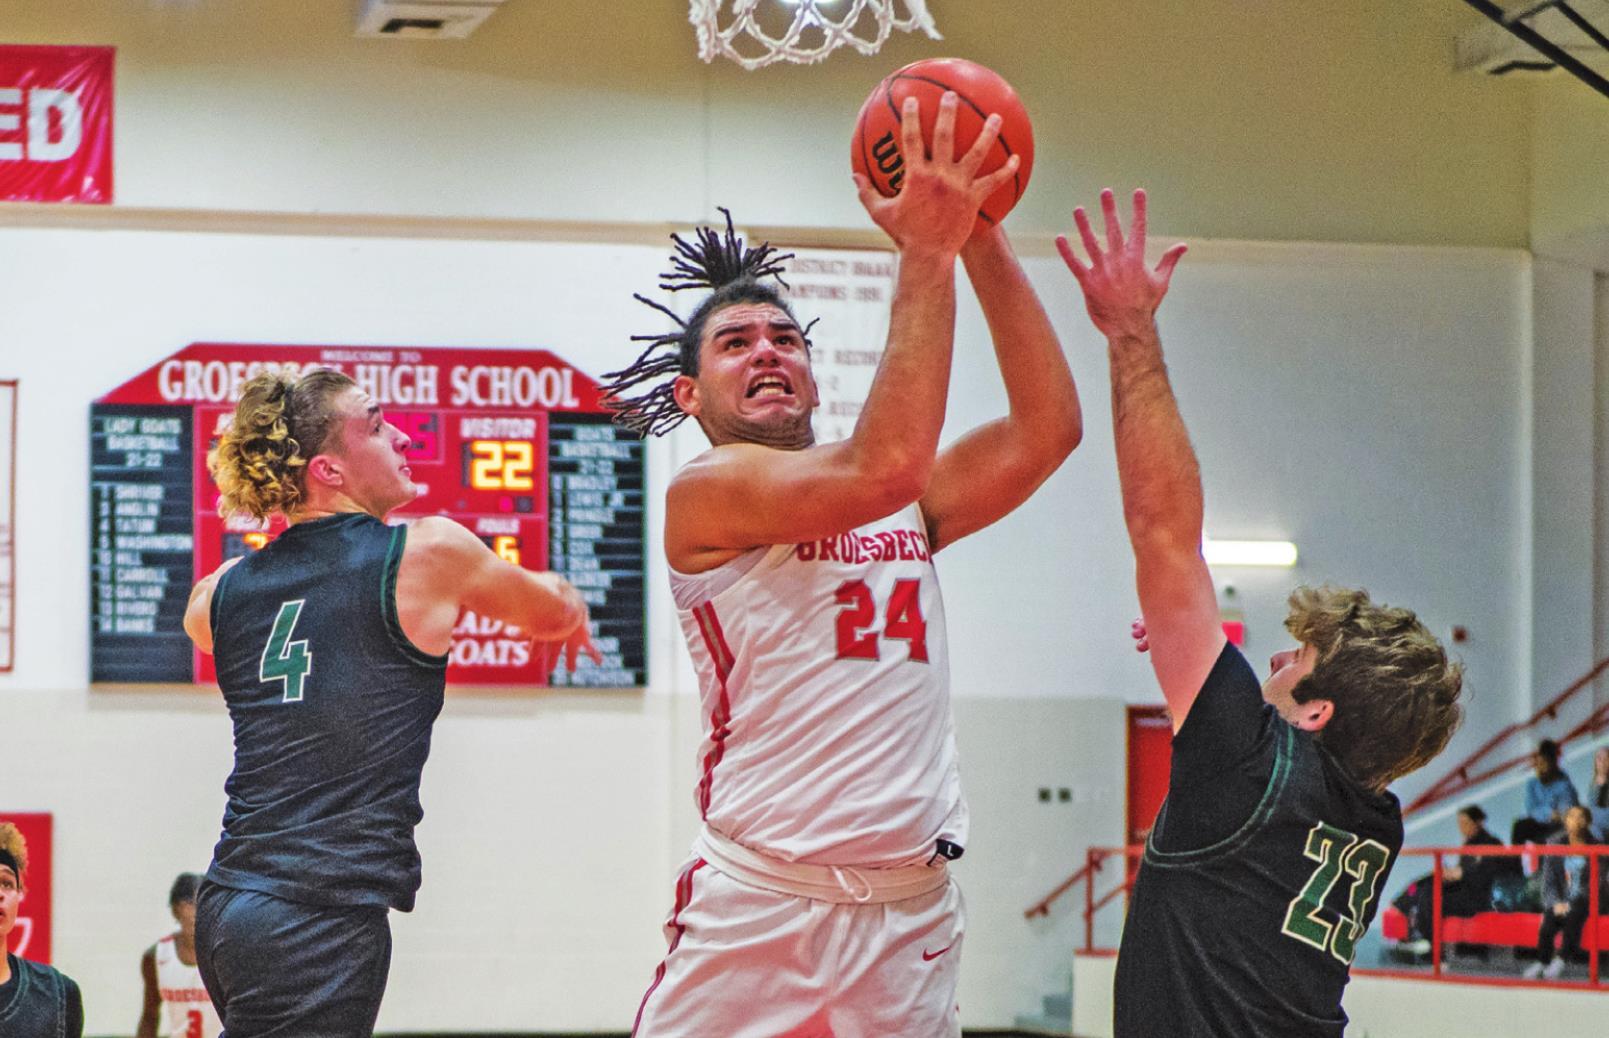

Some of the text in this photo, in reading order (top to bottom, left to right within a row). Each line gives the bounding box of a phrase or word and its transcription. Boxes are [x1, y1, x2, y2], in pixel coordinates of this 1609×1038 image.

[0, 86, 82, 162] ED
[400, 351, 422, 363] TO
[356, 363, 438, 405] HIGH
[452, 365, 580, 408] SCHOOL
[103, 417, 182, 434] LADY GOATS
[460, 417, 537, 439] VISITOR
[106, 434, 180, 450] BASKETBALL
[560, 443, 632, 458] BASKETBALL
[126, 452, 163, 467] 21-22
[471, 441, 534, 489] 22
[115, 534, 194, 550] WASHINGTON
[115, 551, 144, 566] HILL
[833, 577, 930, 664] 24
[259, 598, 313, 703] 4
[1280, 820, 1391, 966] 23
